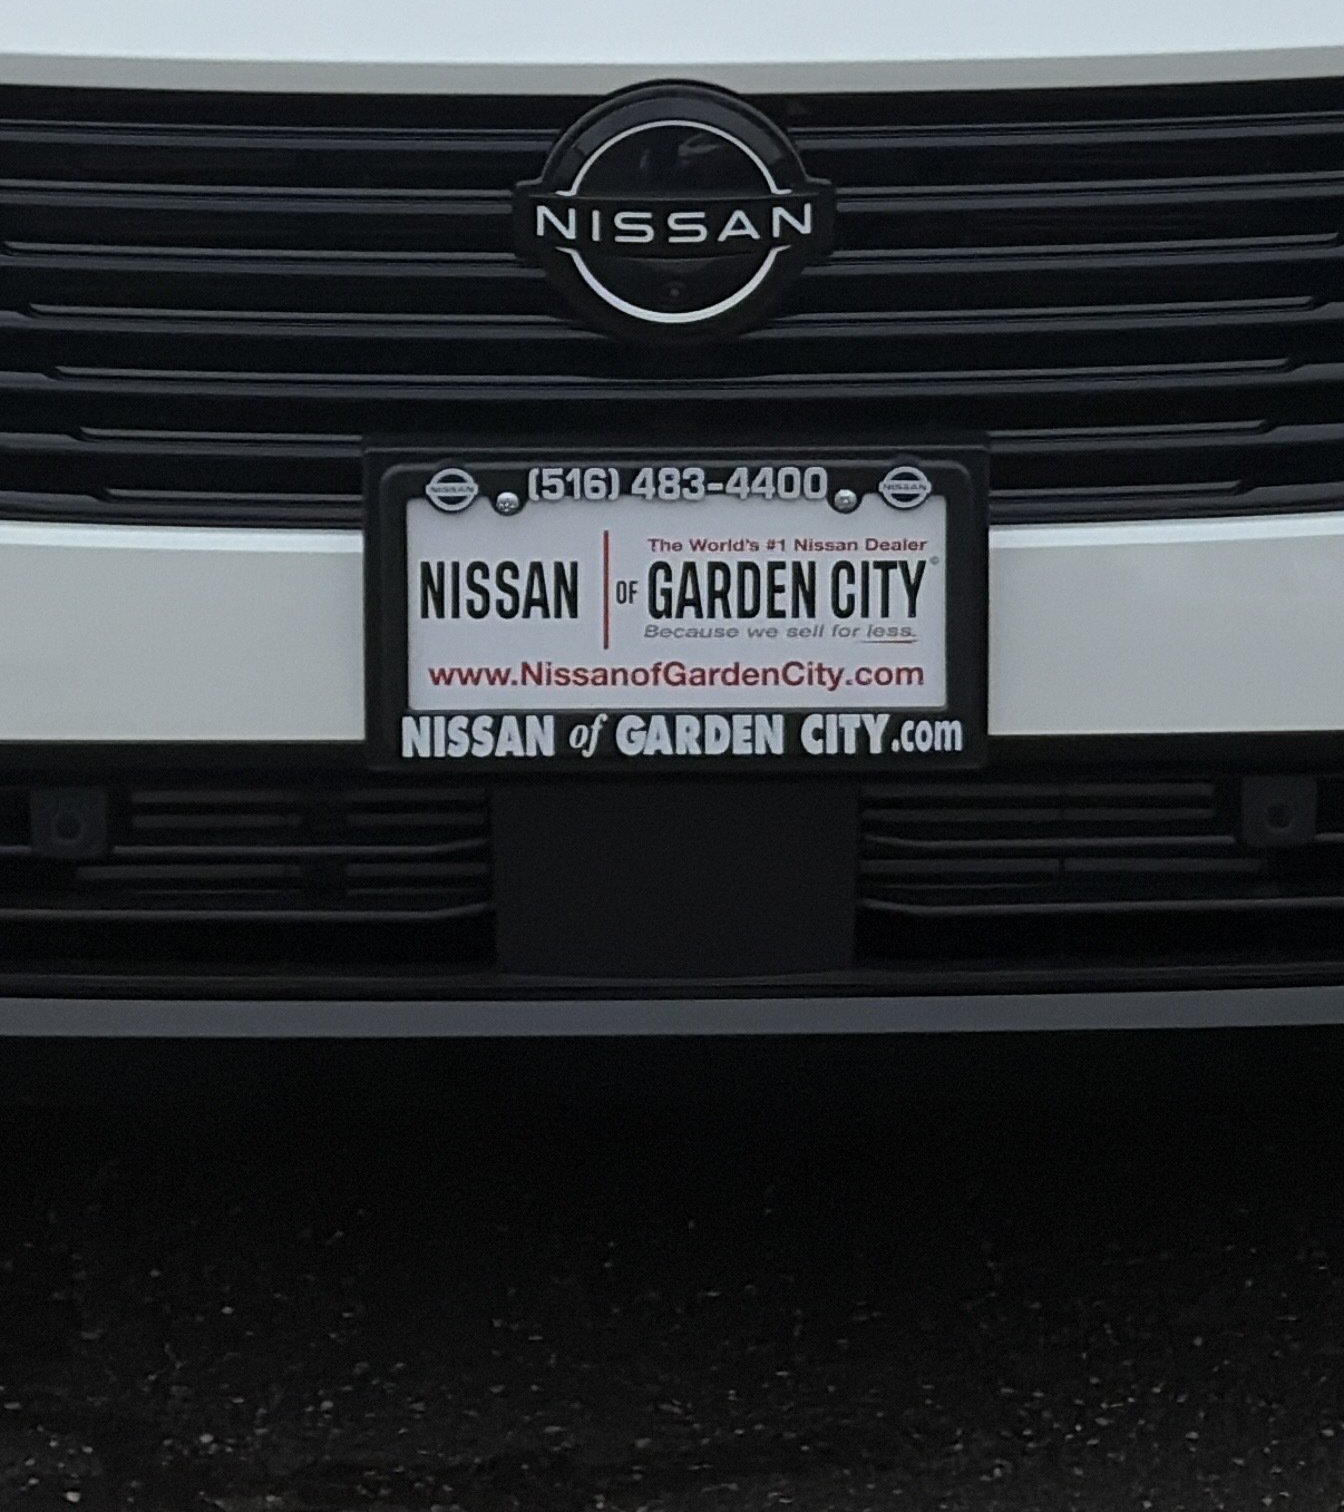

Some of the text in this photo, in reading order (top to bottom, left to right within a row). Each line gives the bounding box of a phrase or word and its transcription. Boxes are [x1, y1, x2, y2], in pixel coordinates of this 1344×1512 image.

[536, 203, 812, 244] NISSAN
[528, 466, 828, 501] (516) 483-4400
[648, 537, 928, 553] The World's #1 Nissan Dealer
[420, 559, 927, 619] NISSAN OF GARDEN CITY
[644, 624, 917, 639] Because we sell for less.
[428, 660, 924, 692] www.NissanofGardenCity.com
[401, 712, 963, 758] NISSAN of GARDEN CITY.com
